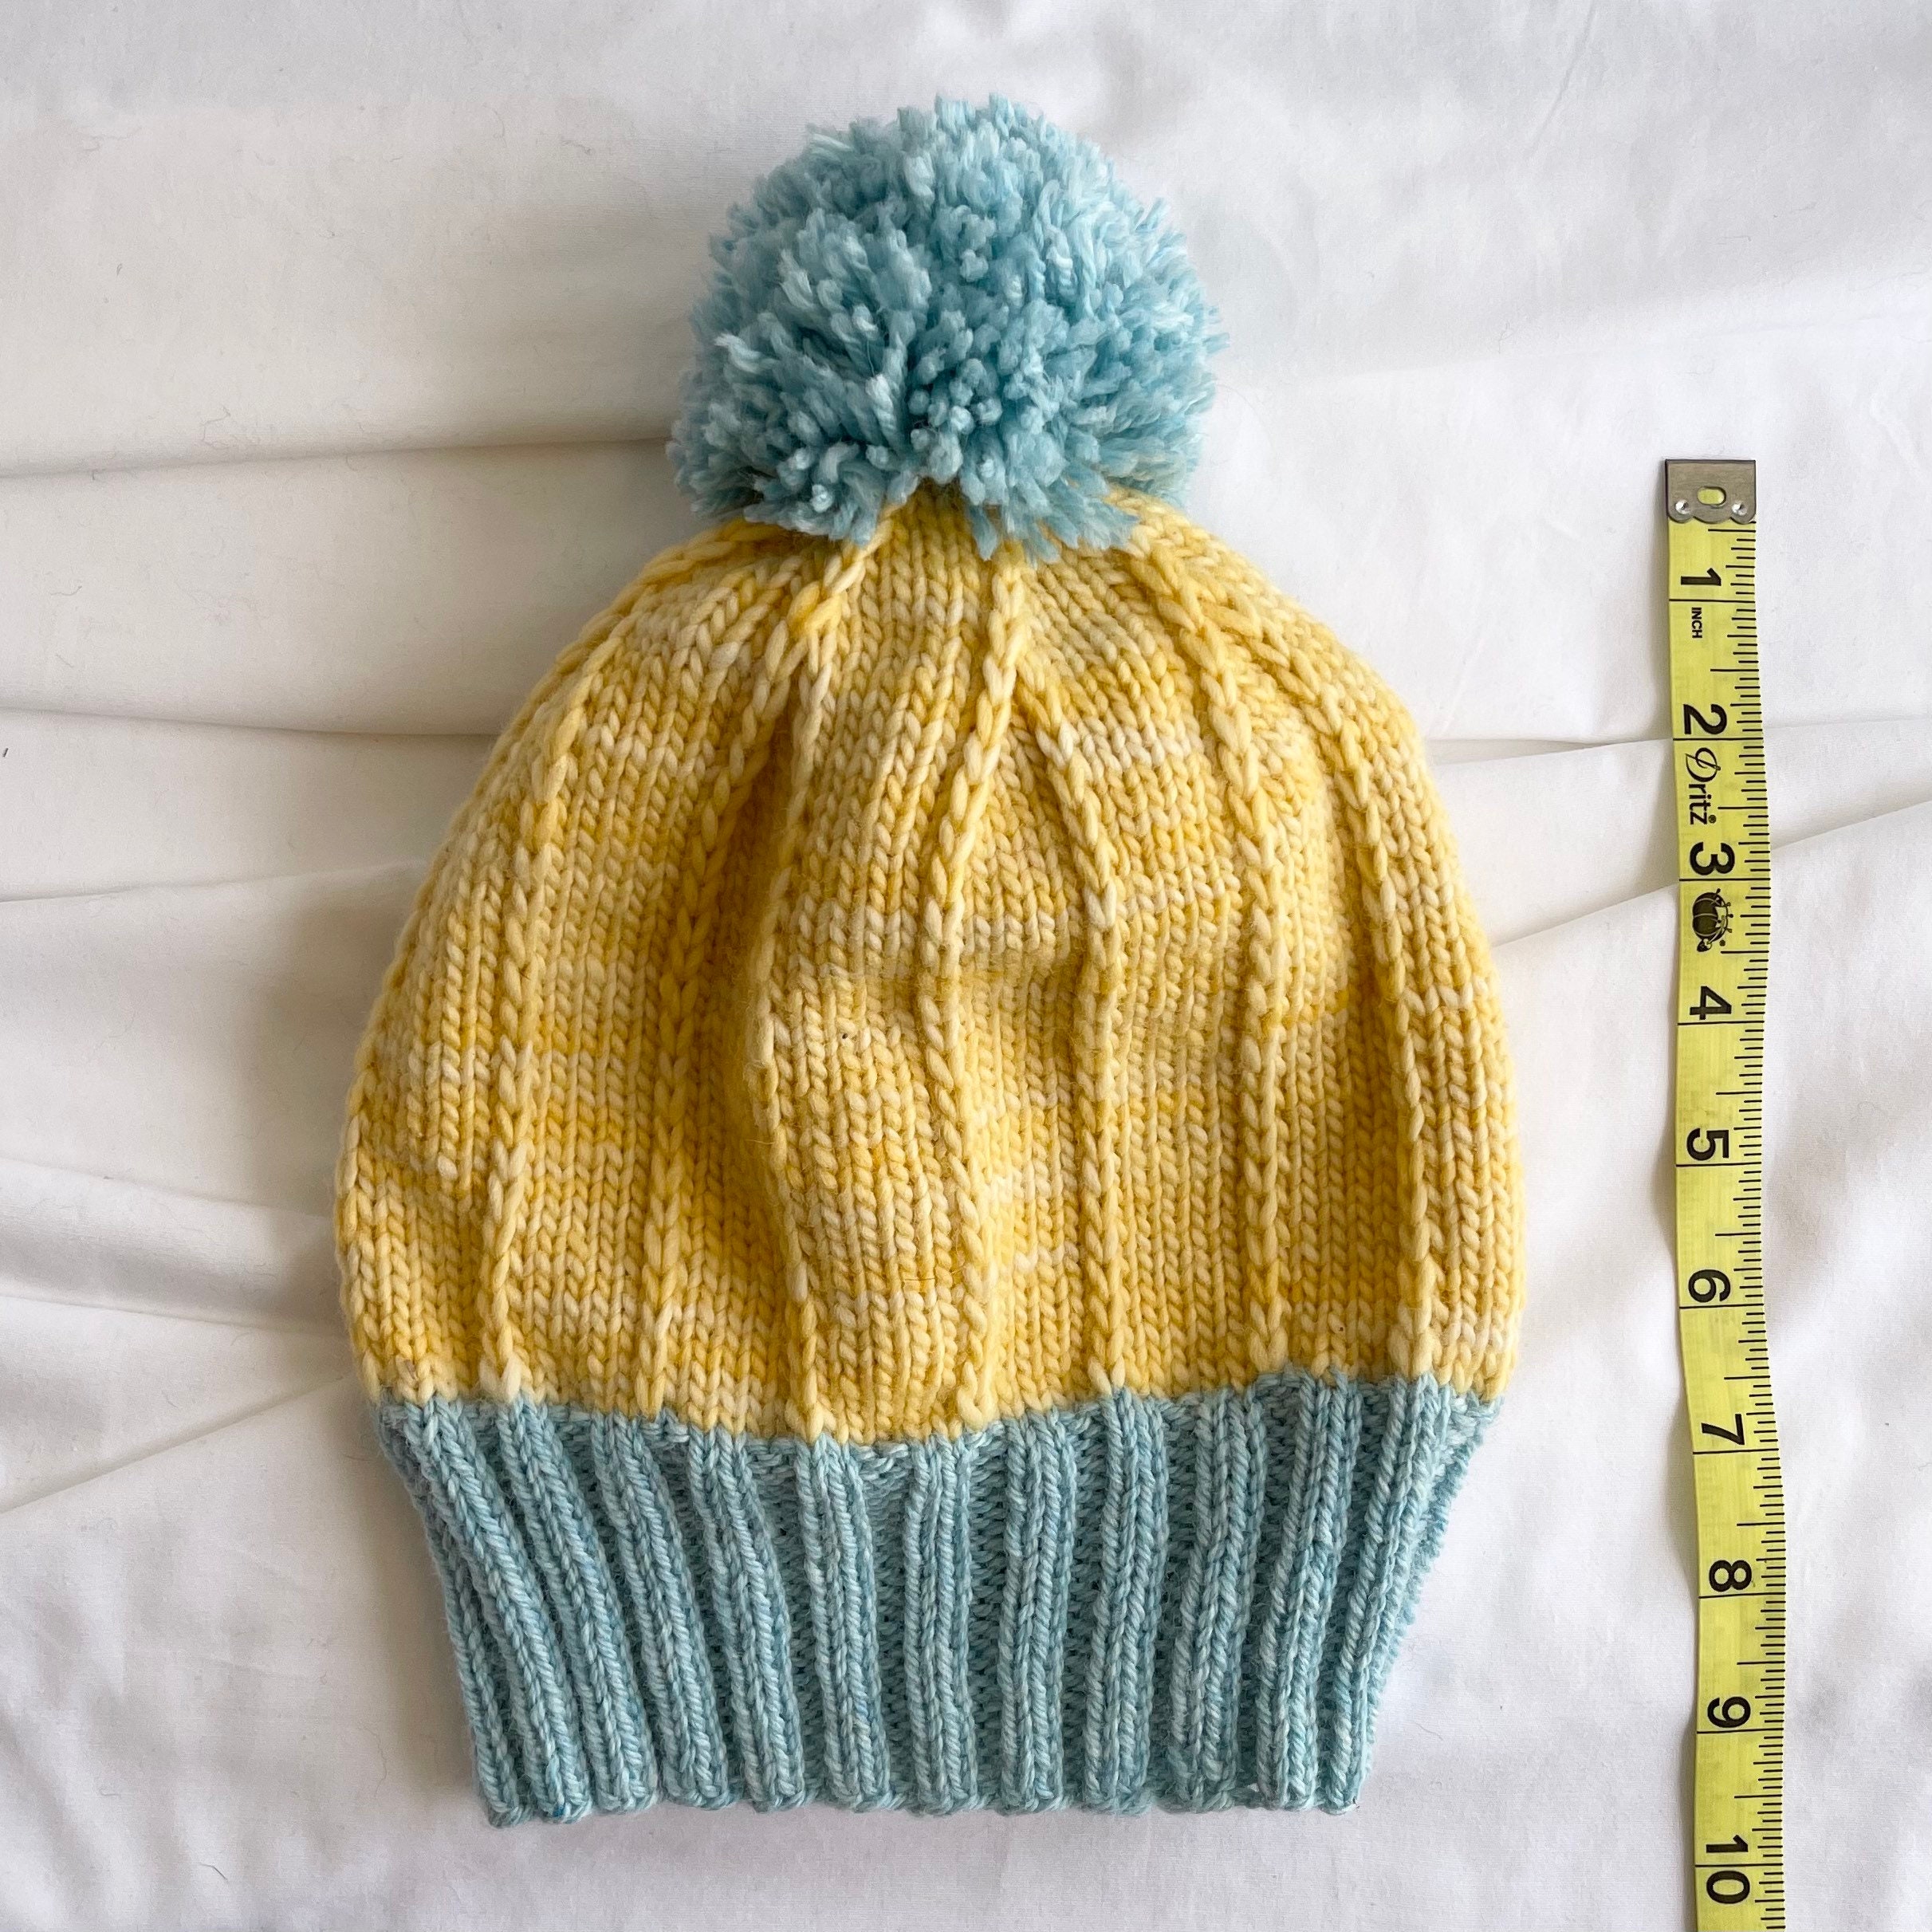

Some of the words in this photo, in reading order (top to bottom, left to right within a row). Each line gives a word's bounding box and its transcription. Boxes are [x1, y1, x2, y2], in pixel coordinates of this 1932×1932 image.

[1680, 567, 1722, 587] 1
[1691, 606, 1703, 639] INCH
[1682, 703, 1728, 735] 2
[1684, 747, 1721, 825] Dritz
[1689, 841, 1736, 876] 3
[1689, 986, 1733, 1021] 4
[1686, 1127, 1729, 1162] 5
[1687, 1269, 1732, 1304] 6
[1701, 1413, 1745, 1446] 7
[1708, 1560, 1753, 1593] 8
[1706, 1696, 1752, 1729] 9
[1706, 1834, 1751, 1905] 10
